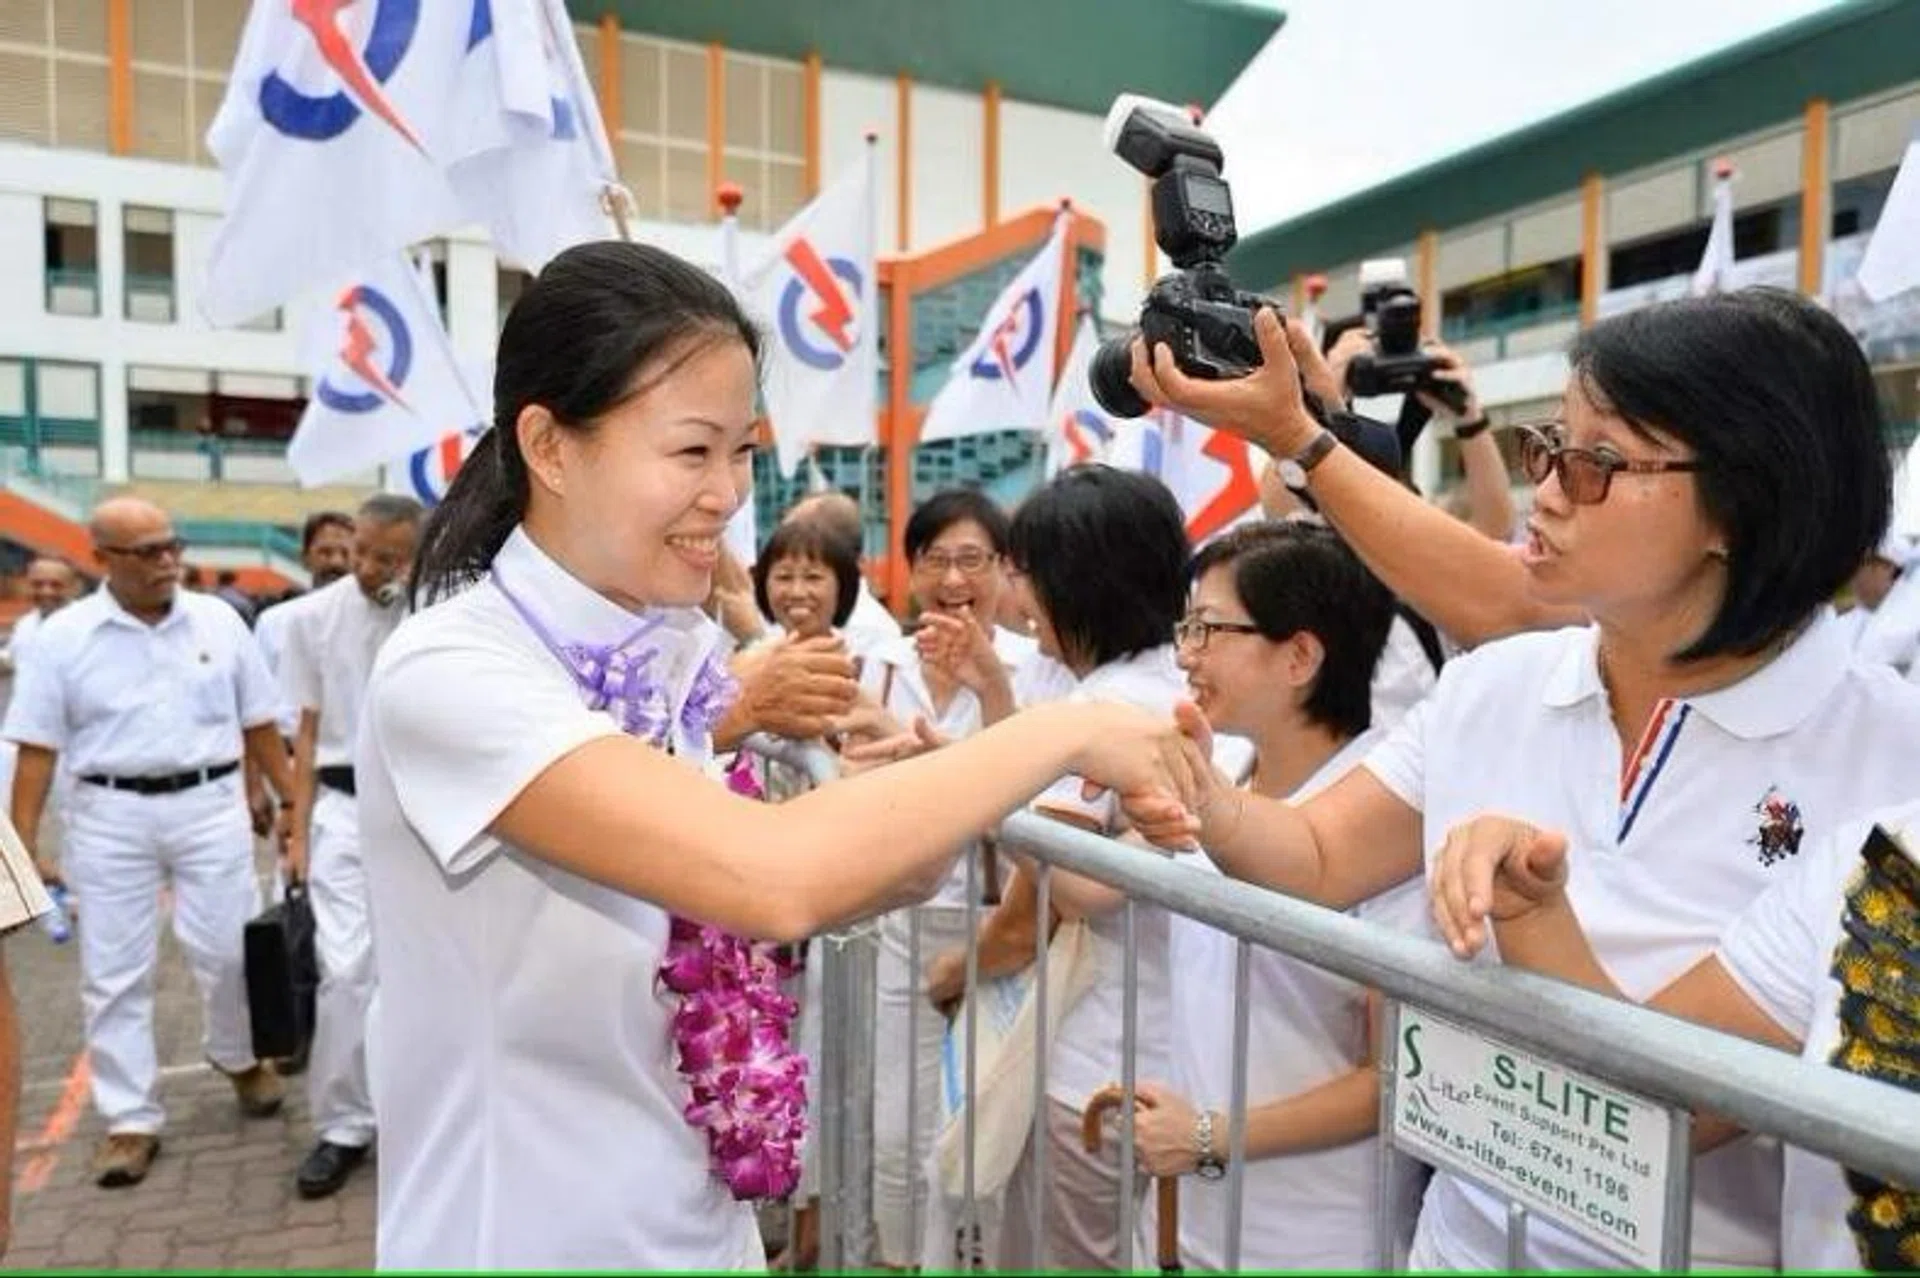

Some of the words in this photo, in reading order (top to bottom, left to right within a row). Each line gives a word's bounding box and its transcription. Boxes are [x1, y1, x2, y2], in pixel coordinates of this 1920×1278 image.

[1474, 1084, 1516, 1114] Event
[1520, 1106, 1583, 1147] Support
[1588, 1137, 1616, 1162] Pte
[1621, 1152, 1651, 1178] Ltd
[1490, 1119, 1523, 1151] Tel:
[1494, 1054, 1630, 1143] S-LITE
[1404, 1107, 1637, 1241] www.s-lite-event.com
